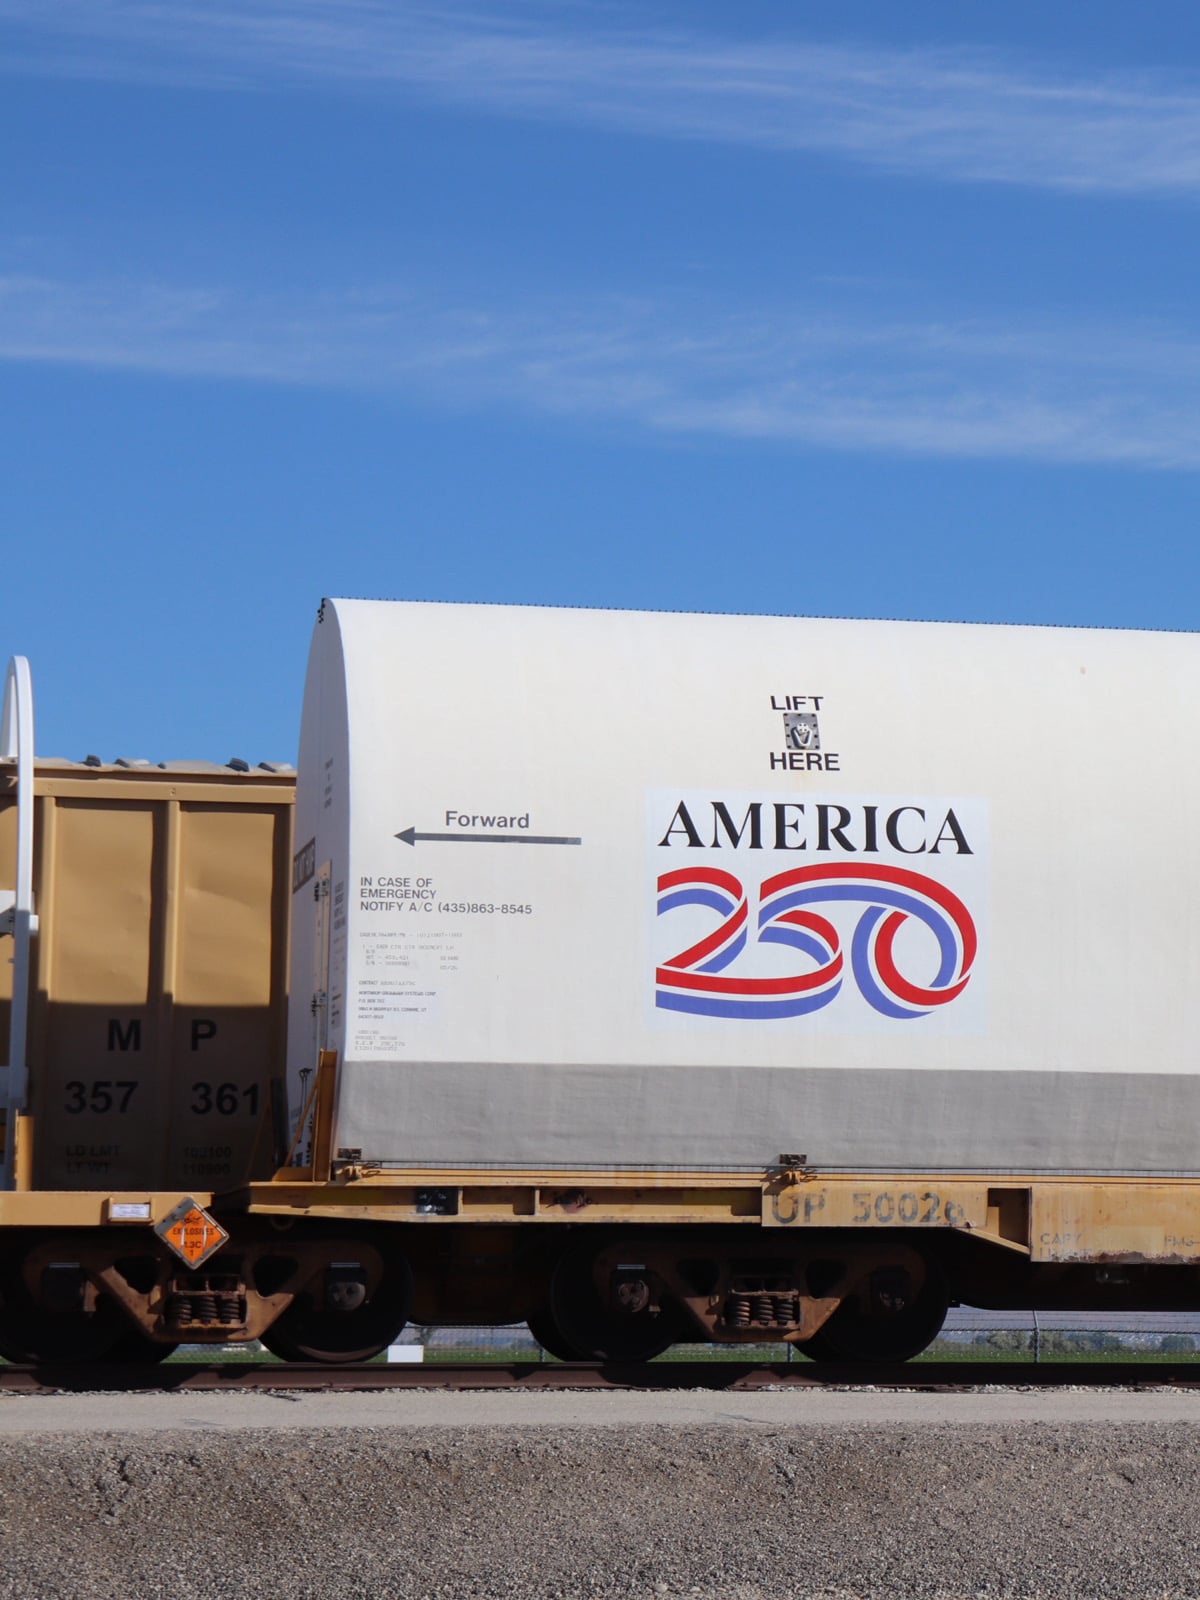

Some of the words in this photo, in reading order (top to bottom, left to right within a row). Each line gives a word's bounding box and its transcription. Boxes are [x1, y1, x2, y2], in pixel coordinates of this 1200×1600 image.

[770, 696, 823, 711] LIFT
[769, 752, 841, 772] HERE
[445, 810, 530, 829] Forward
[657, 800, 974, 855] AMERICA
[360, 876, 373, 887] IN
[377, 876, 411, 888] CASE
[415, 877, 433, 888] OF
[360, 888, 437, 899] EMERGENCY
[360, 901, 403, 912] NOTIFY
[408, 901, 433, 913] A/C
[437, 902, 533, 915] (435)863-8545
[655, 861, 978, 1020] 250
[107, 1018, 142, 1052] M
[190, 1019, 217, 1052] P
[63, 1080, 139, 1115] 357
[190, 1081, 259, 1117] 361
[771, 1191, 826, 1224] UP
